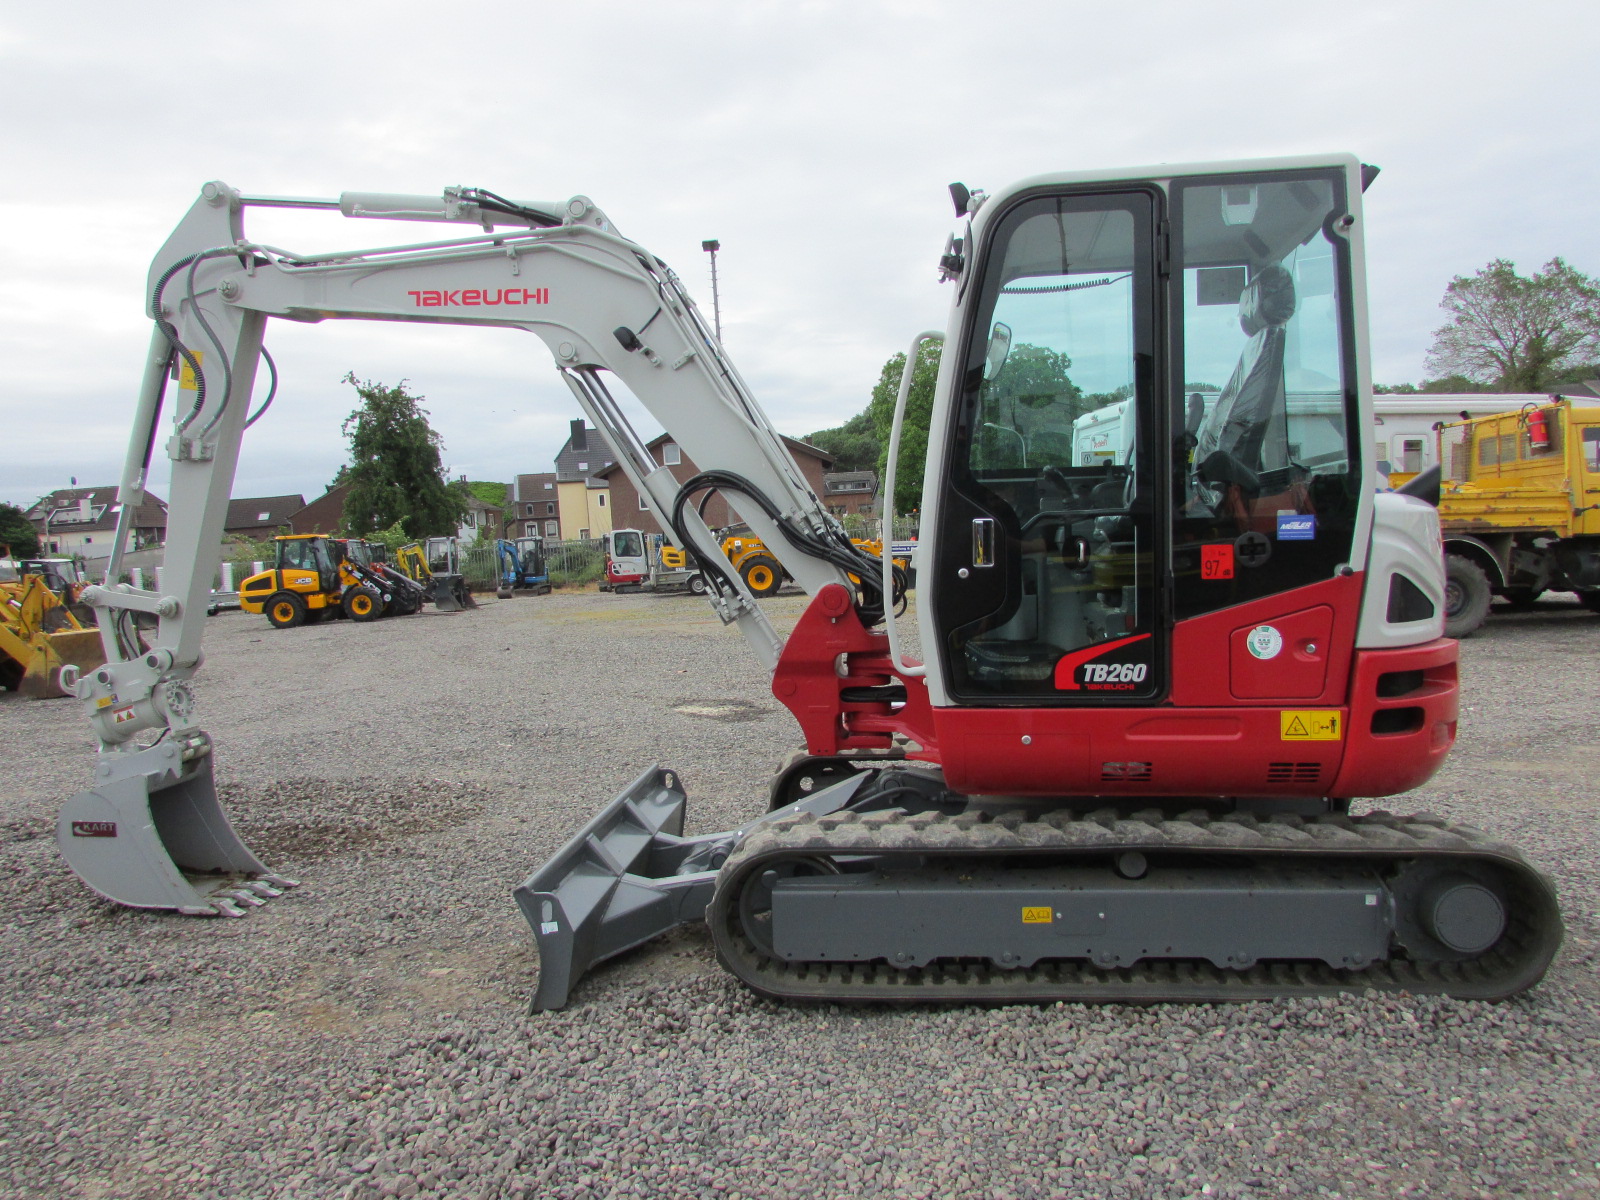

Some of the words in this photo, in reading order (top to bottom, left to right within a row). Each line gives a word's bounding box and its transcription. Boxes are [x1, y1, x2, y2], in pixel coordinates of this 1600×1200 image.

[407, 287, 549, 307] TAKEUCHI
[1205, 560, 1220, 576] 97
[295, 577, 313, 585] JCB
[362, 578, 381, 594] JCB
[1084, 663, 1147, 682] TB260
[83, 823, 114, 831] KART
